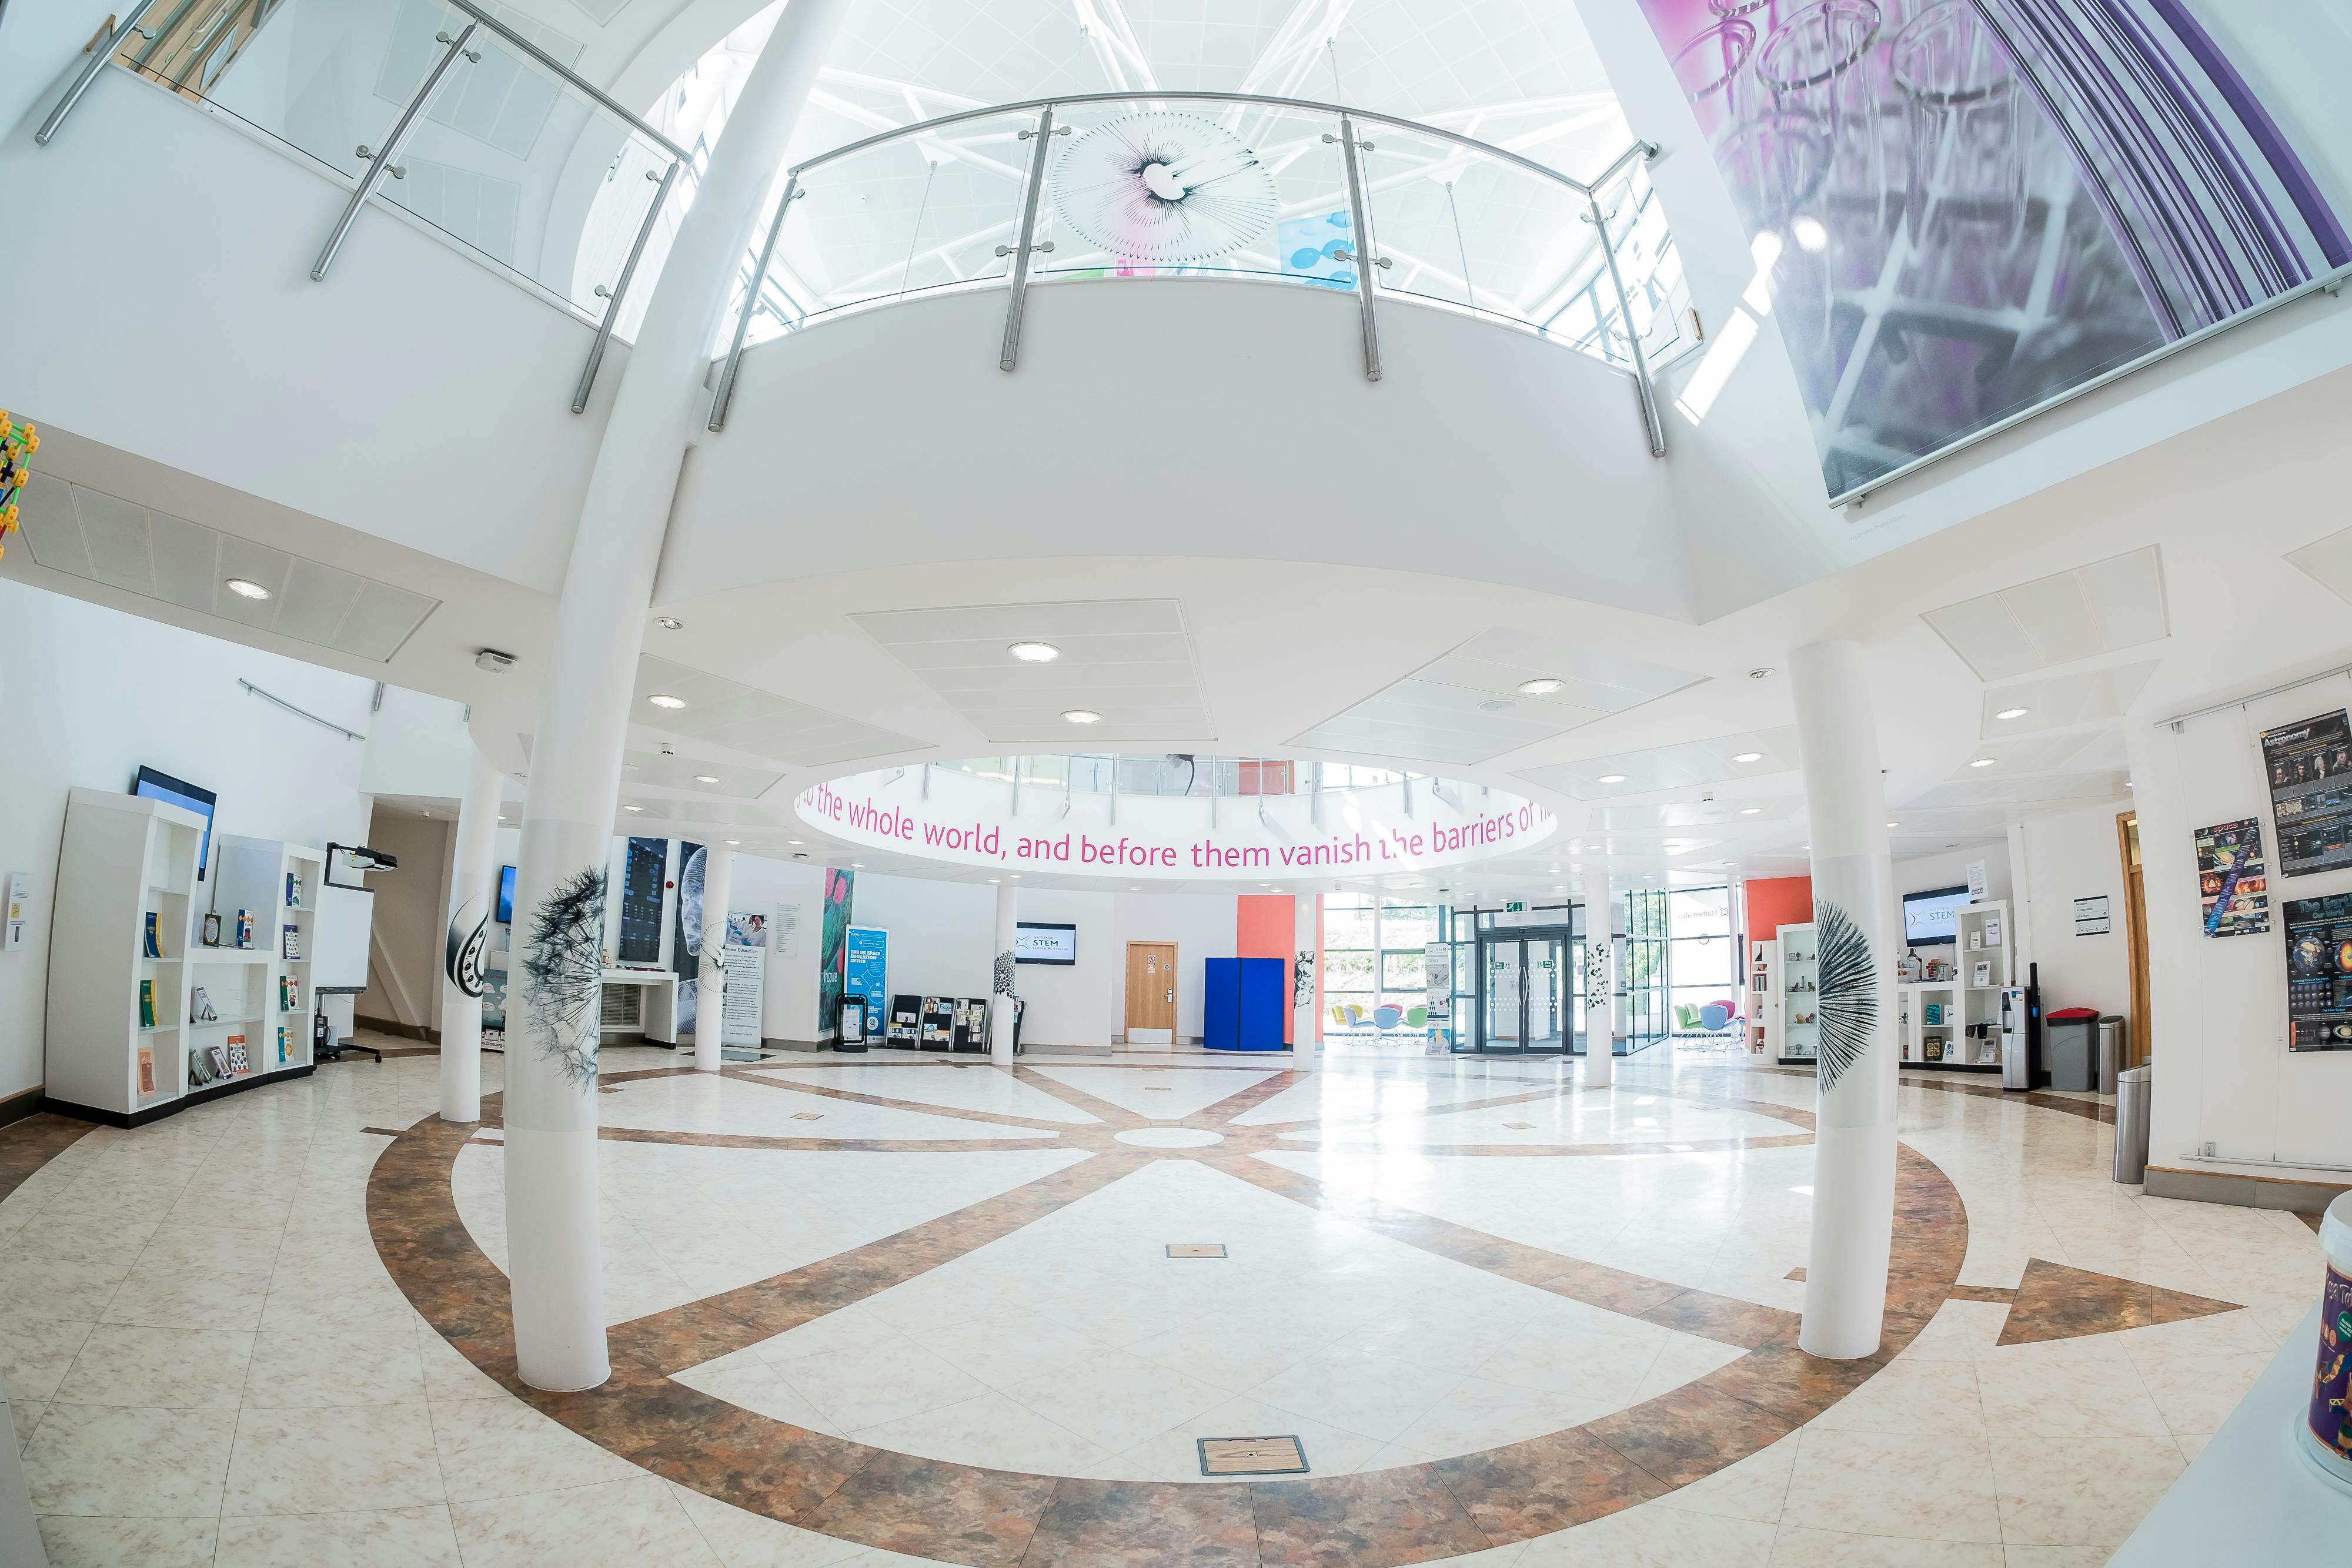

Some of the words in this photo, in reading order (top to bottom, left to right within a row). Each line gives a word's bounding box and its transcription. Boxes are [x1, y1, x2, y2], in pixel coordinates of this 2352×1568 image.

[1874, 521, 1889, 531] Photo
[1890, 513, 1908, 523] Library
[2264, 728, 2310, 747] Astronomy
[818, 781, 843, 821] the
[848, 798, 914, 841] whole
[924, 823, 1007, 861] world,
[1017, 833, 1070, 862] and
[1081, 835, 1177, 867] before
[1191, 840, 1270, 868] them
[1279, 833, 1371, 866] vanish
[1379, 828, 1424, 860] the
[1433, 813, 1515, 853] barriers
[1519, 800, 1534, 831] of
[2213, 823, 2238, 834] space
[2298, 900, 2320, 913] The
[2326, 908, 2344, 917] World
[1930, 911, 1955, 921] STEM
[824, 969, 838, 987] Inspire
